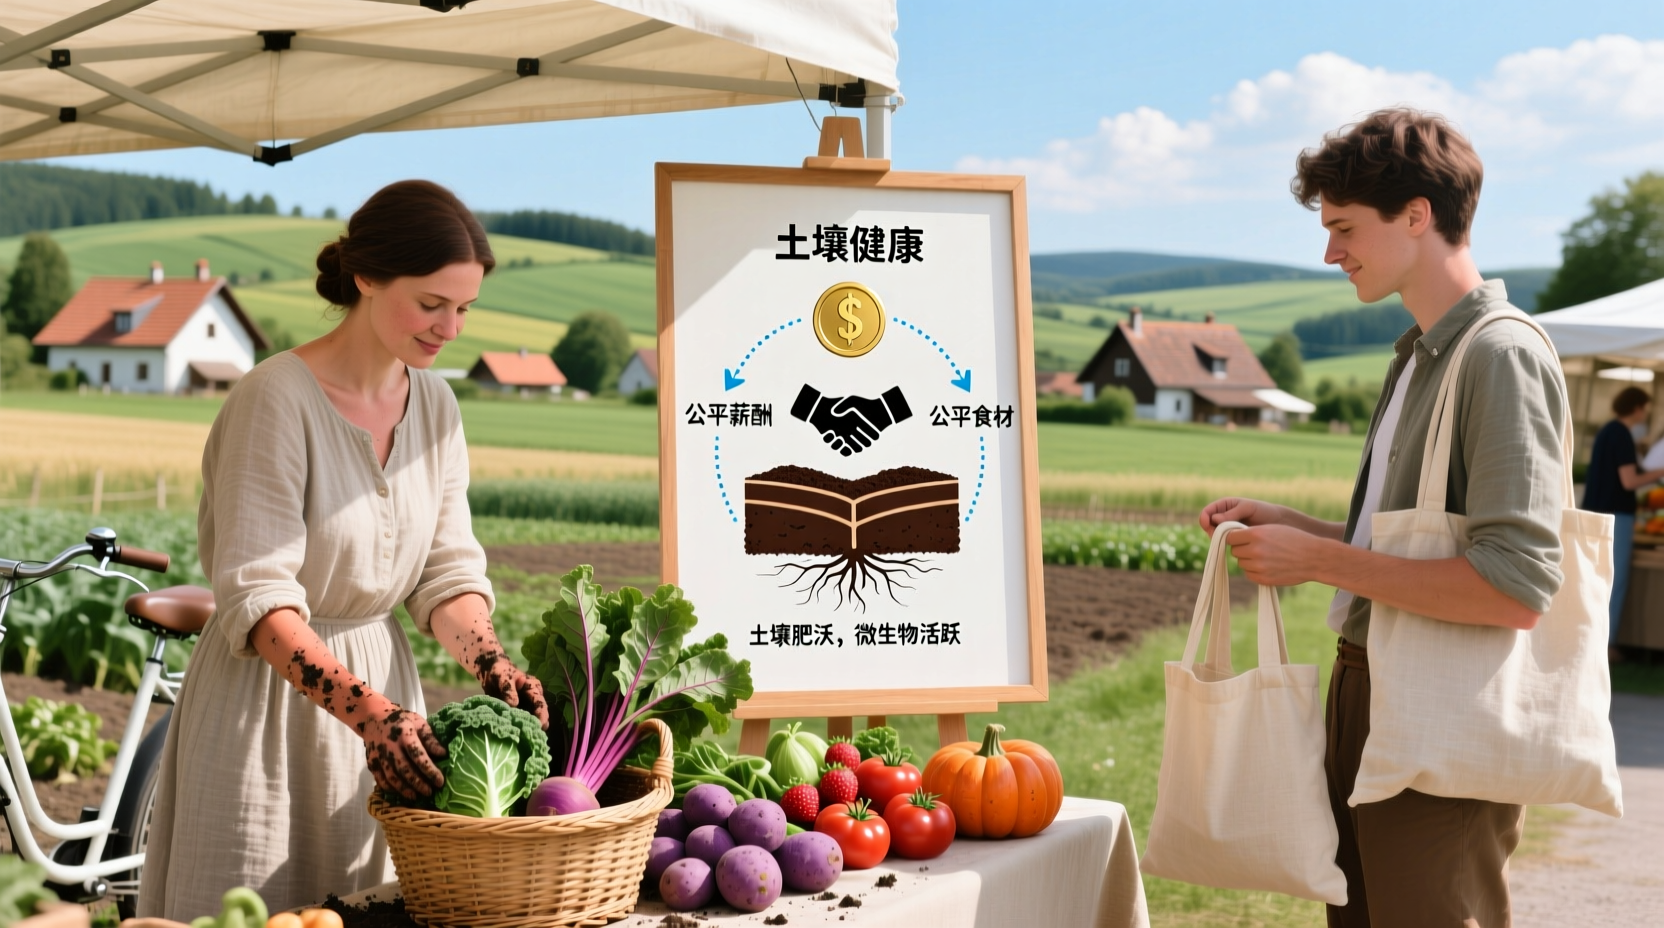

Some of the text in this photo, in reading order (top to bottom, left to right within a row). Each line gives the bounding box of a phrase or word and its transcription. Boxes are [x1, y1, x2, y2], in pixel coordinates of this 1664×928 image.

[775, 223, 924, 264] 土壤健康
[685, 402, 773, 428] 公平薪酬
[929, 404, 1015, 429] 公平食材
[749, 621, 961, 649] 土壤肥沃，微生物活跃
